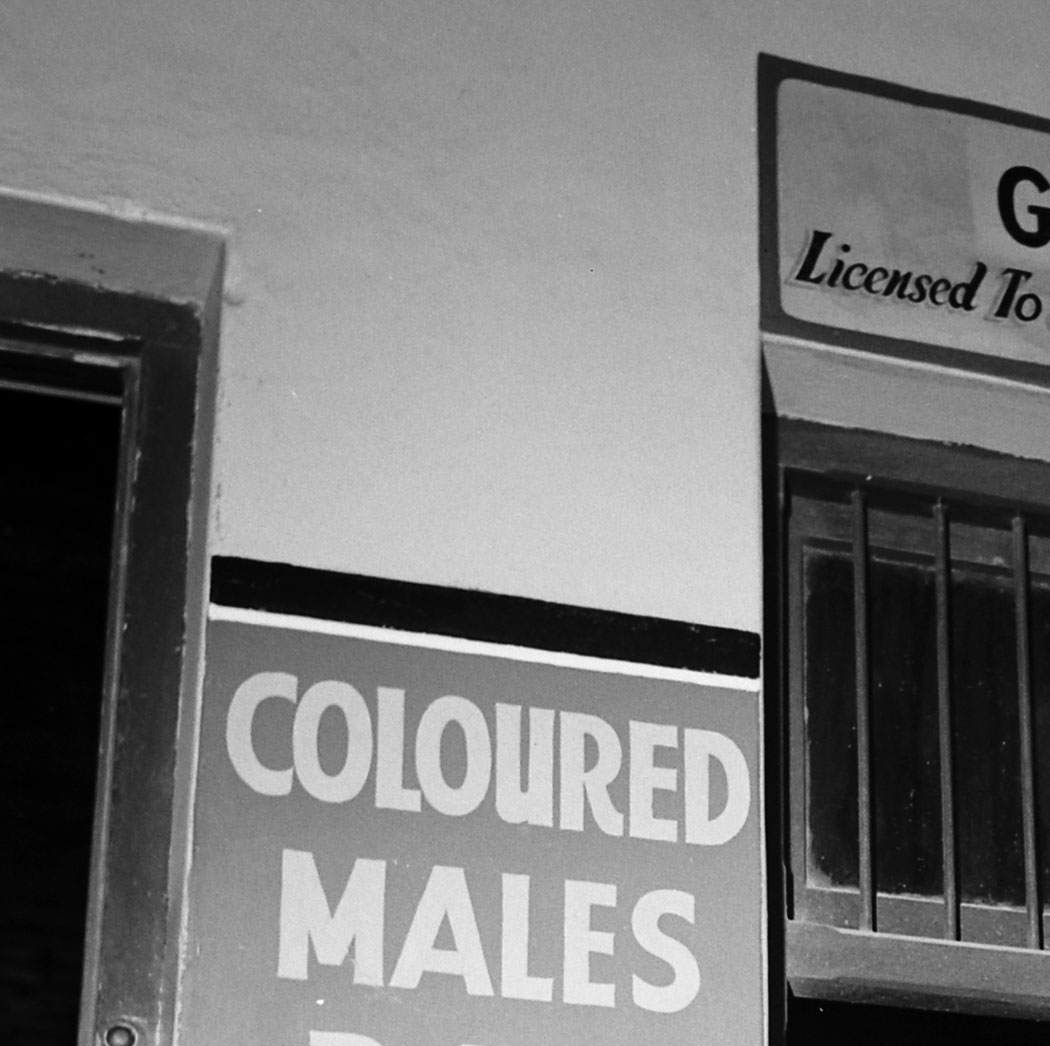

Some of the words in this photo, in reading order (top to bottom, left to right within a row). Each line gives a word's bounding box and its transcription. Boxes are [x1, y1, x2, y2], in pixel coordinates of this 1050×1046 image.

[795, 229, 987, 311] Licensed
[993, 267, 1042, 322] To
[225, 671, 751, 845] COLOURED
[277, 848, 701, 1013] MALES
